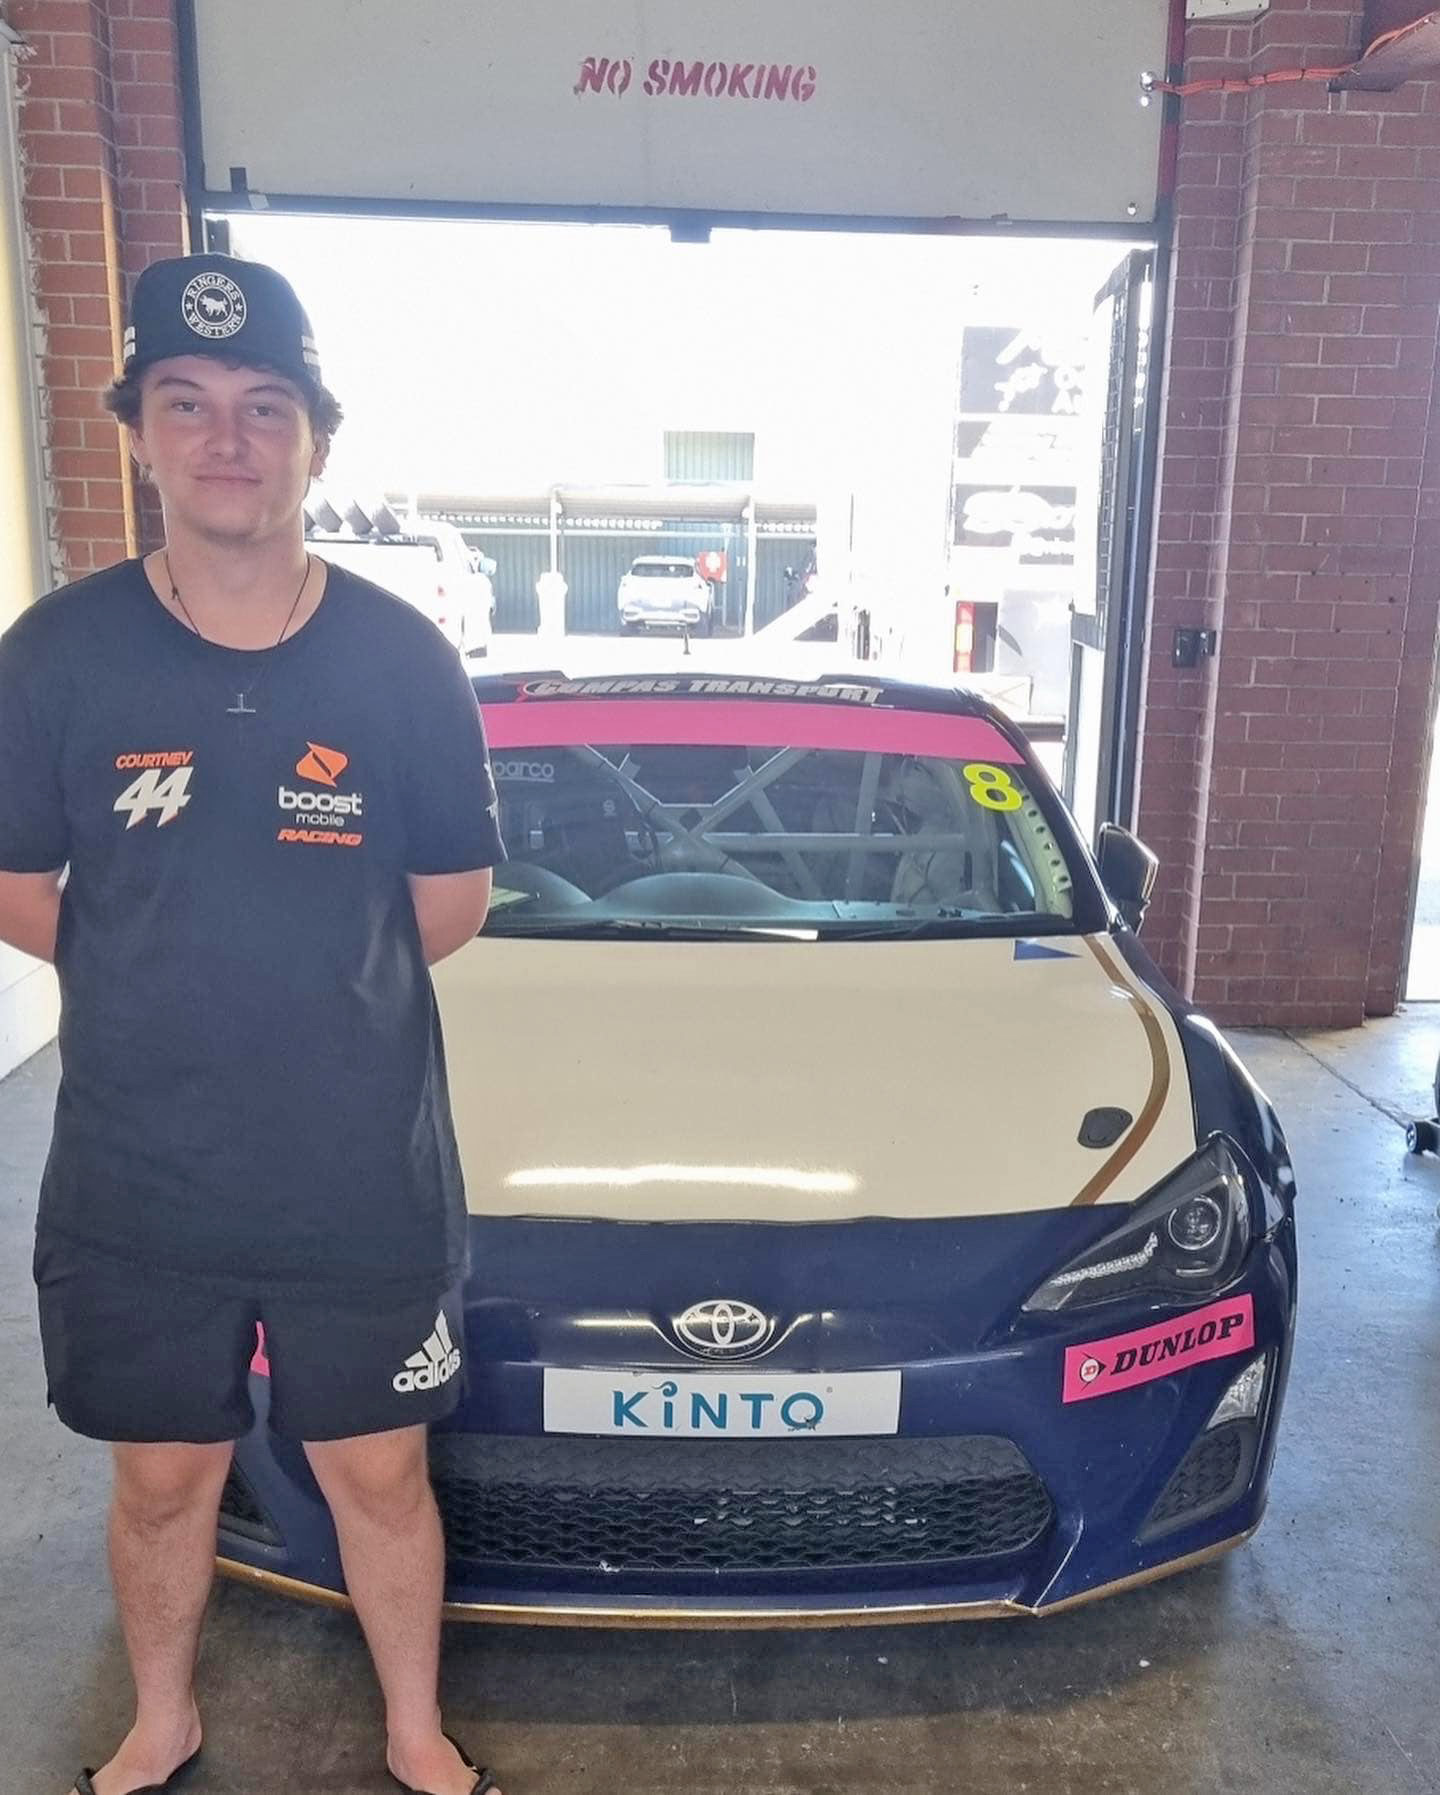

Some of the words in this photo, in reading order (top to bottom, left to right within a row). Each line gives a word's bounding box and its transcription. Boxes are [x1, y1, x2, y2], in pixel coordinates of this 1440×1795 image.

[573, 56, 633, 97] NO
[643, 59, 816, 101] SMOKING
[186, 275, 241, 301] RINGERS
[188, 312, 242, 336] WESTERN
[688, 679, 884, 704] TRANSPORT
[115, 751, 193, 769] COURTNEY
[493, 761, 555, 778] parco
[113, 766, 194, 830] 44
[963, 763, 1022, 811] 8
[278, 785, 363, 816] boost
[295, 812, 345, 827] mobile
[277, 828, 362, 846] RACING
[1110, 1313, 1244, 1376] DUNLOP
[392, 1348, 461, 1392] adidas
